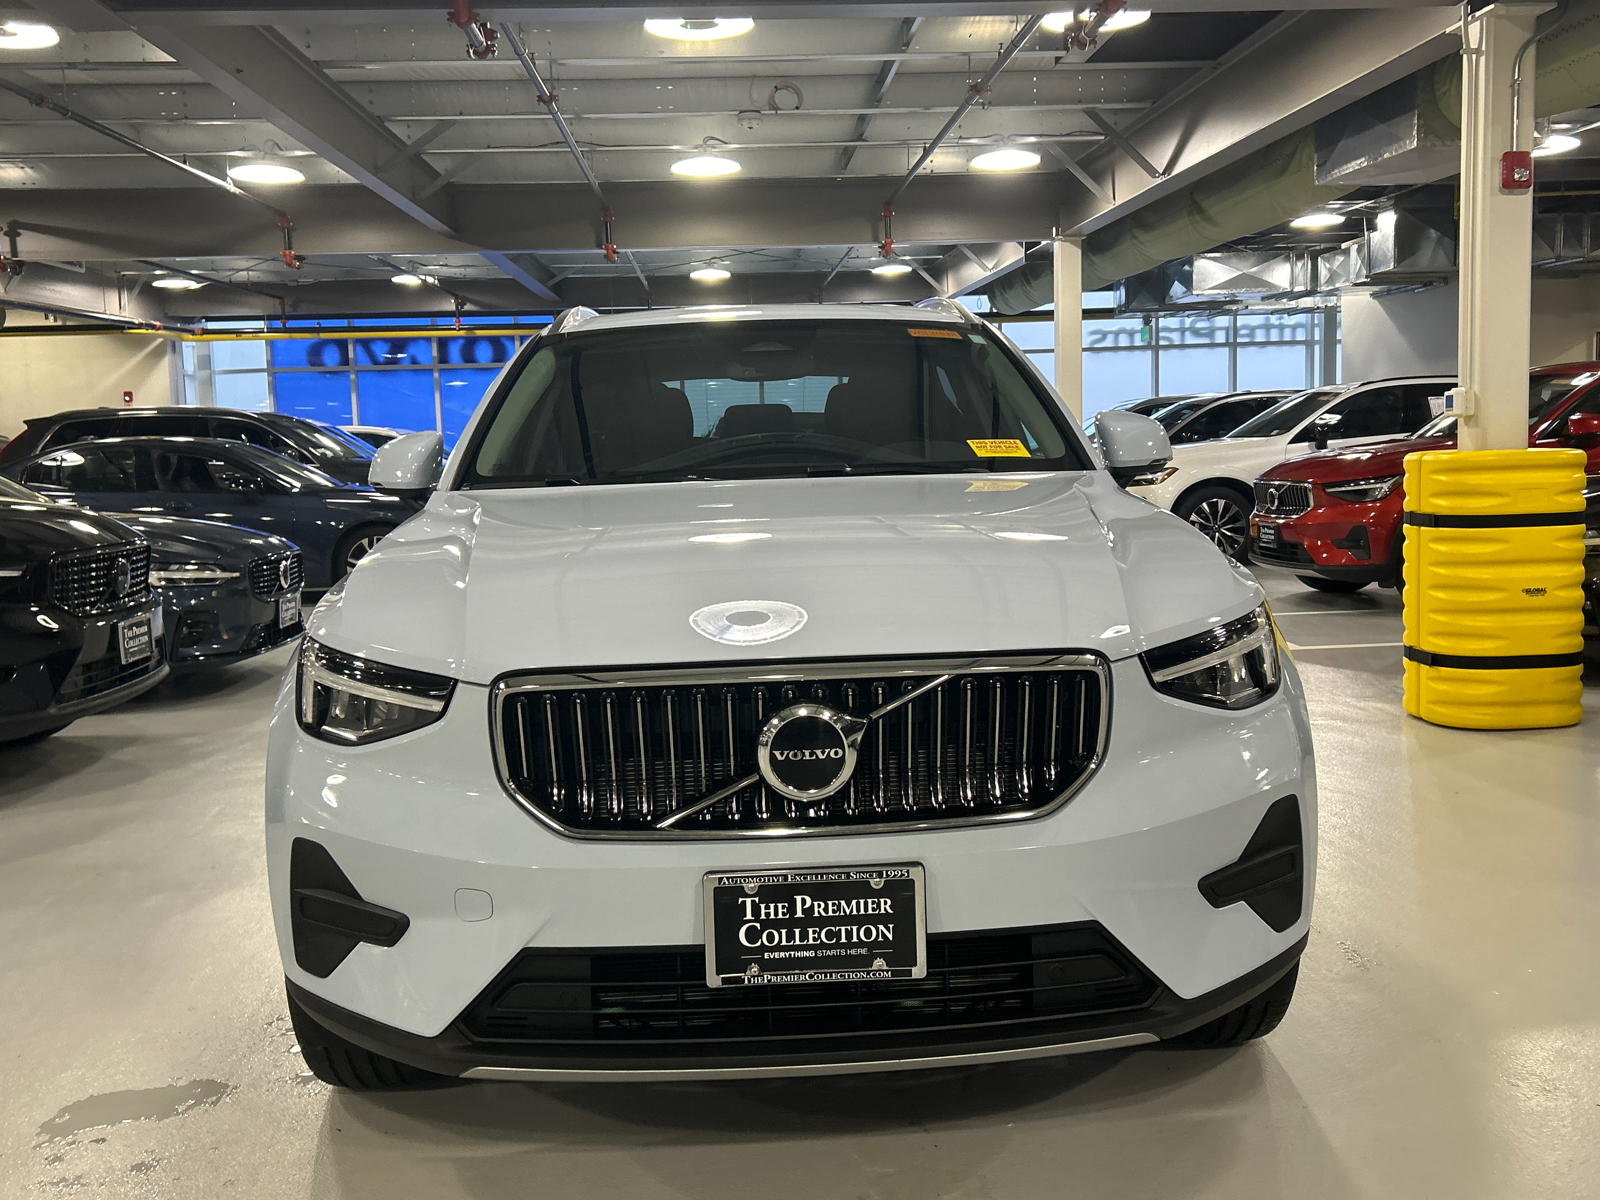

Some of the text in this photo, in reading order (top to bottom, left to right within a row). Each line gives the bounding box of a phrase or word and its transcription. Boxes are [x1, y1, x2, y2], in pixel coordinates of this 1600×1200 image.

[772, 748, 843, 760] VOLVO
[720, 869, 908, 885] AUTOMOTIVE EXCELLENCE SINCE 1995
[738, 894, 894, 921] THE PREMIER
[738, 923, 895, 948] COLLECTION
[764, 947, 870, 959] EVERYTHING STARTS HERE.
